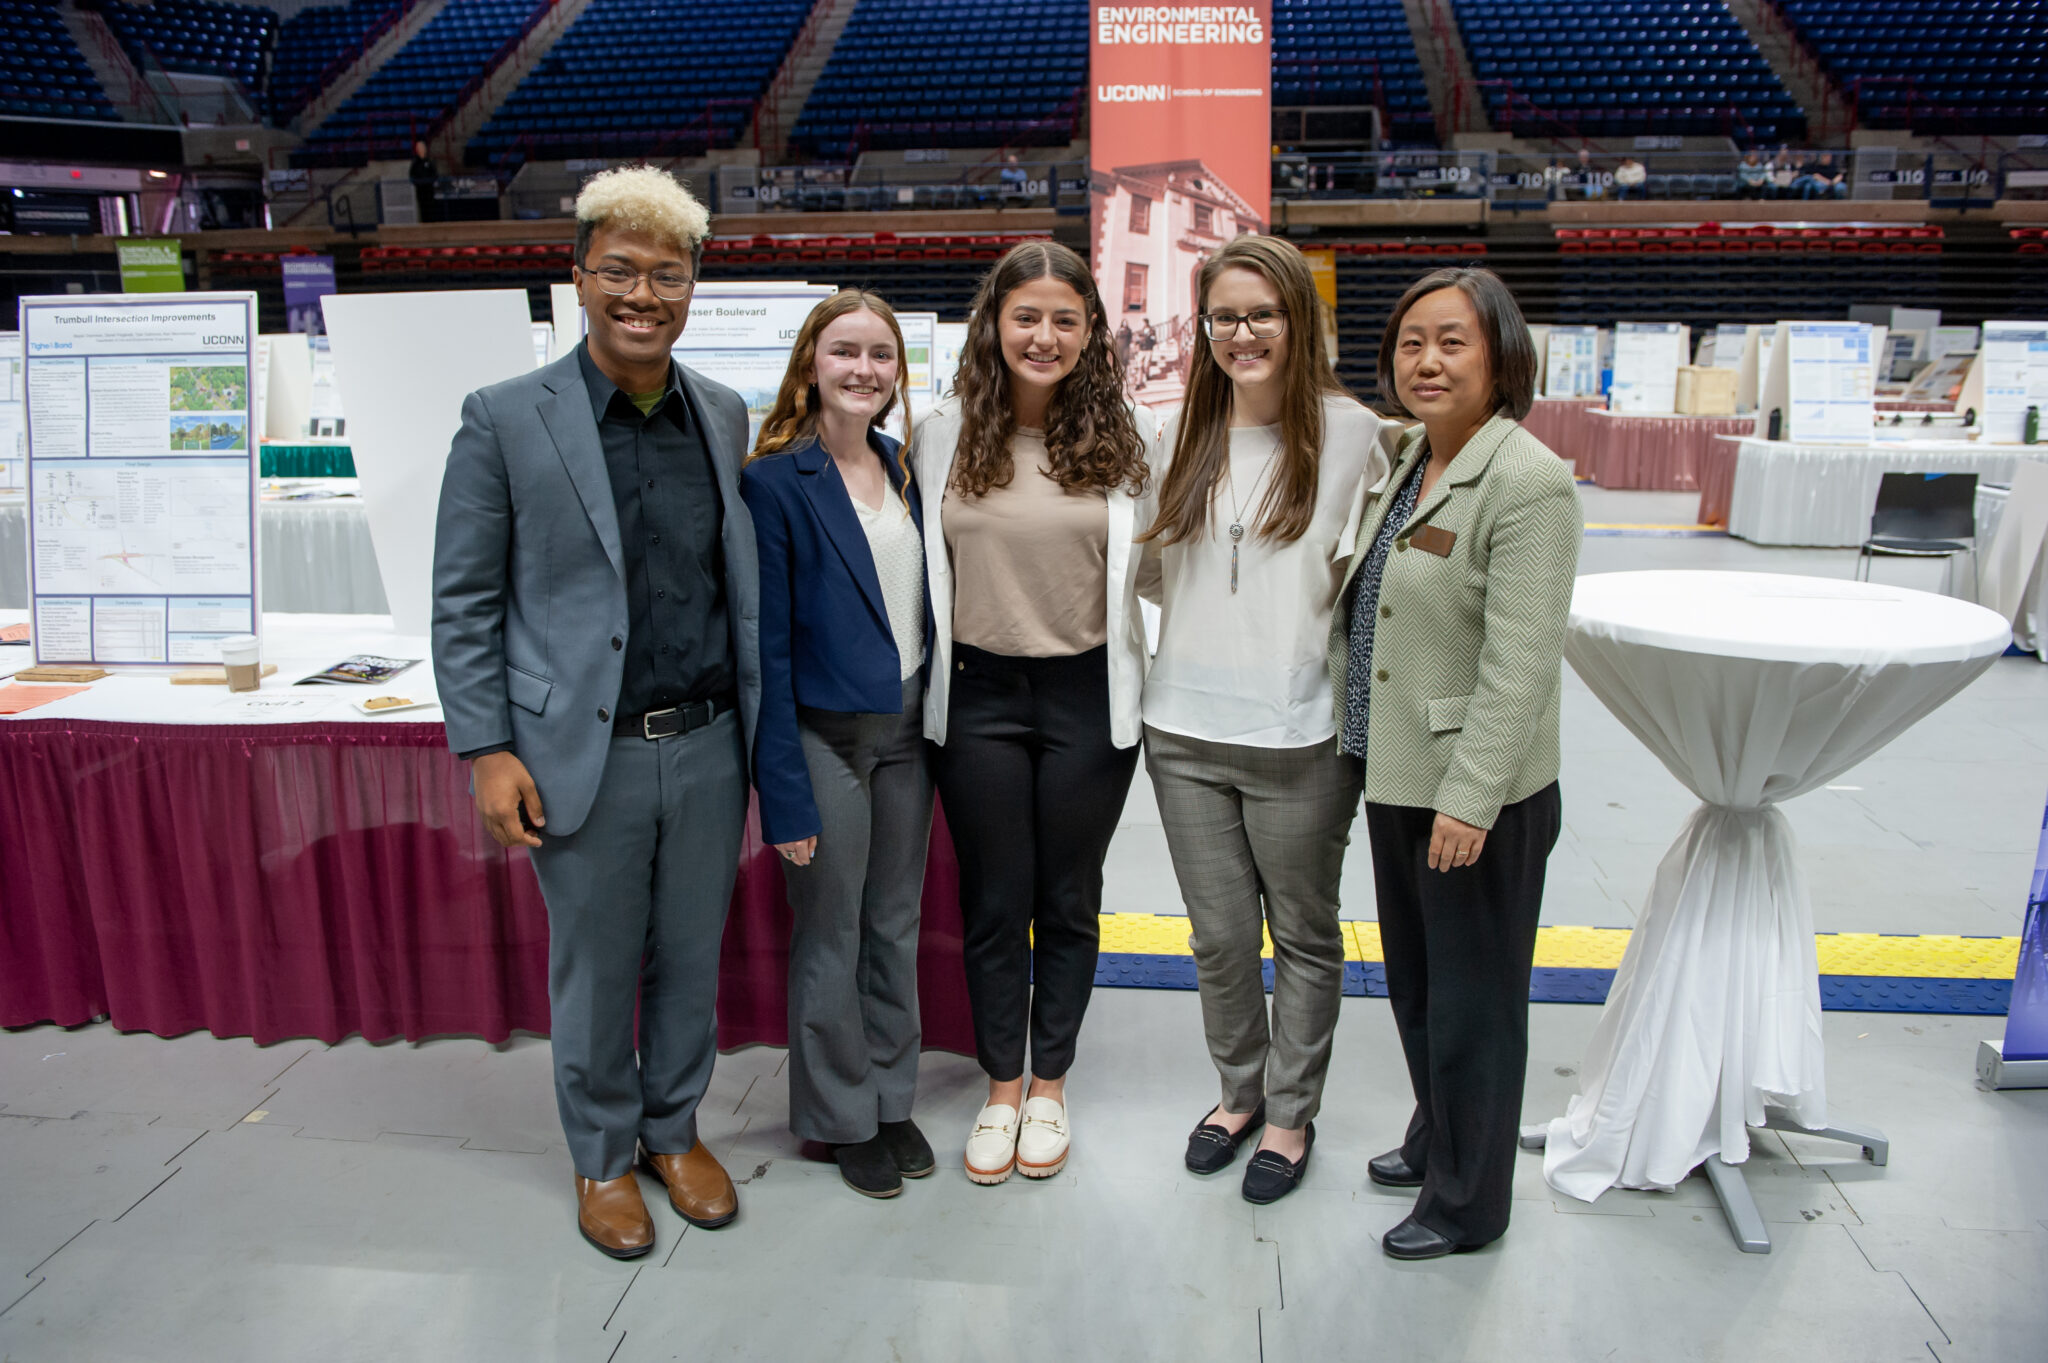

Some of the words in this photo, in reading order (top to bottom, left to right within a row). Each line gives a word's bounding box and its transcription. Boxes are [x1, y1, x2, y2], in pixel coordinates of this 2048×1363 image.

[1098, 7, 1260, 23] ENVIRONMENTAL
[1098, 24, 1263, 44] ENGINEERING
[1098, 85, 1166, 101] UCONN
[1440, 167, 1471, 182] 109
[54, 315, 93, 324] Trumbull
[95, 314, 149, 324] Intersection
[151, 313, 216, 323] Improvements
[716, 308, 767, 316] Boulevard
[202, 335, 244, 345] UCONN
